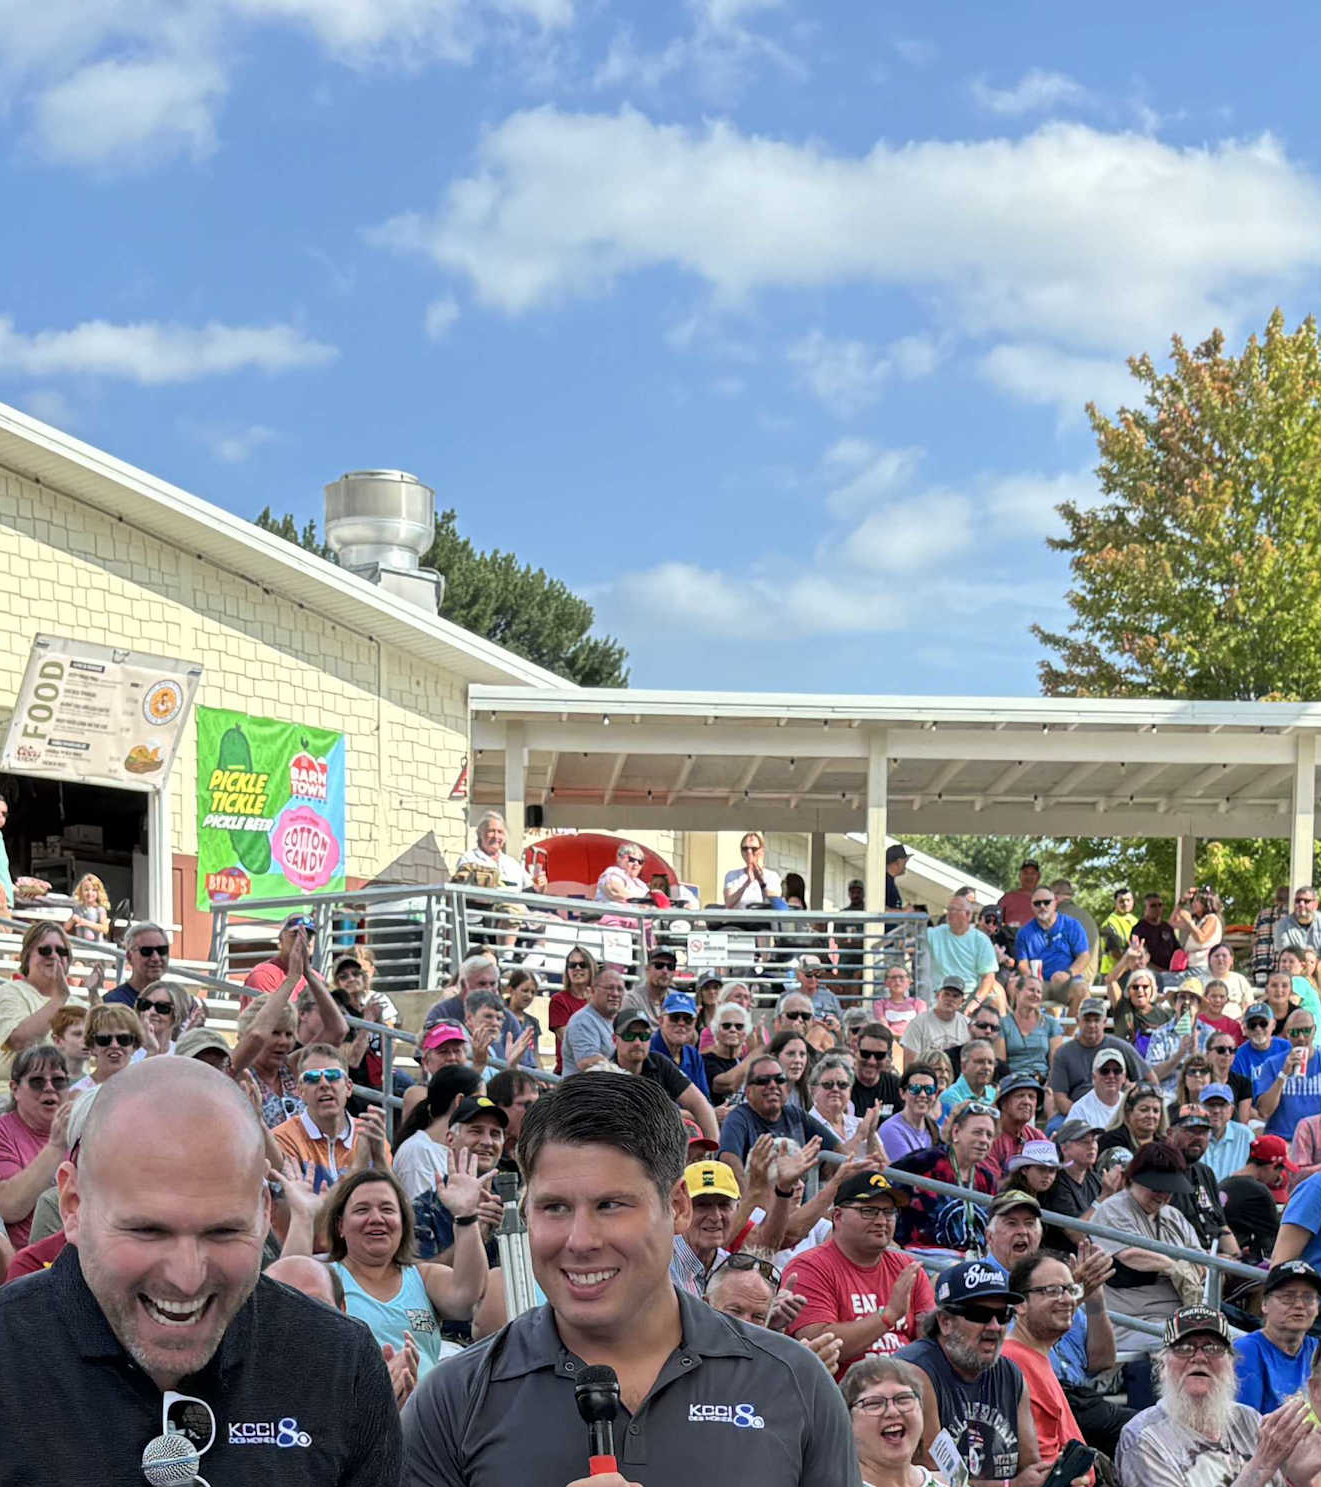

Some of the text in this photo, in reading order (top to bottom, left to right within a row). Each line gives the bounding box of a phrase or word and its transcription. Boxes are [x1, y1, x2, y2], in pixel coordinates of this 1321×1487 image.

[21, 659, 65, 740] FOOD
[209, 769, 269, 795] PICKLE
[291, 769, 327, 785] BARN
[291, 780, 327, 798] TOWN
[211, 791, 269, 815] TICKLE
[202, 814, 245, 830] PICKLE
[244, 816, 274, 832] BEER
[284, 826, 328, 852] COTTON
[285, 849, 326, 872] CANDY
[208, 874, 249, 893] BIRD'S
[689, 1403, 755, 1427] KCCI 8
[228, 1417, 298, 1447] KCCI 8
